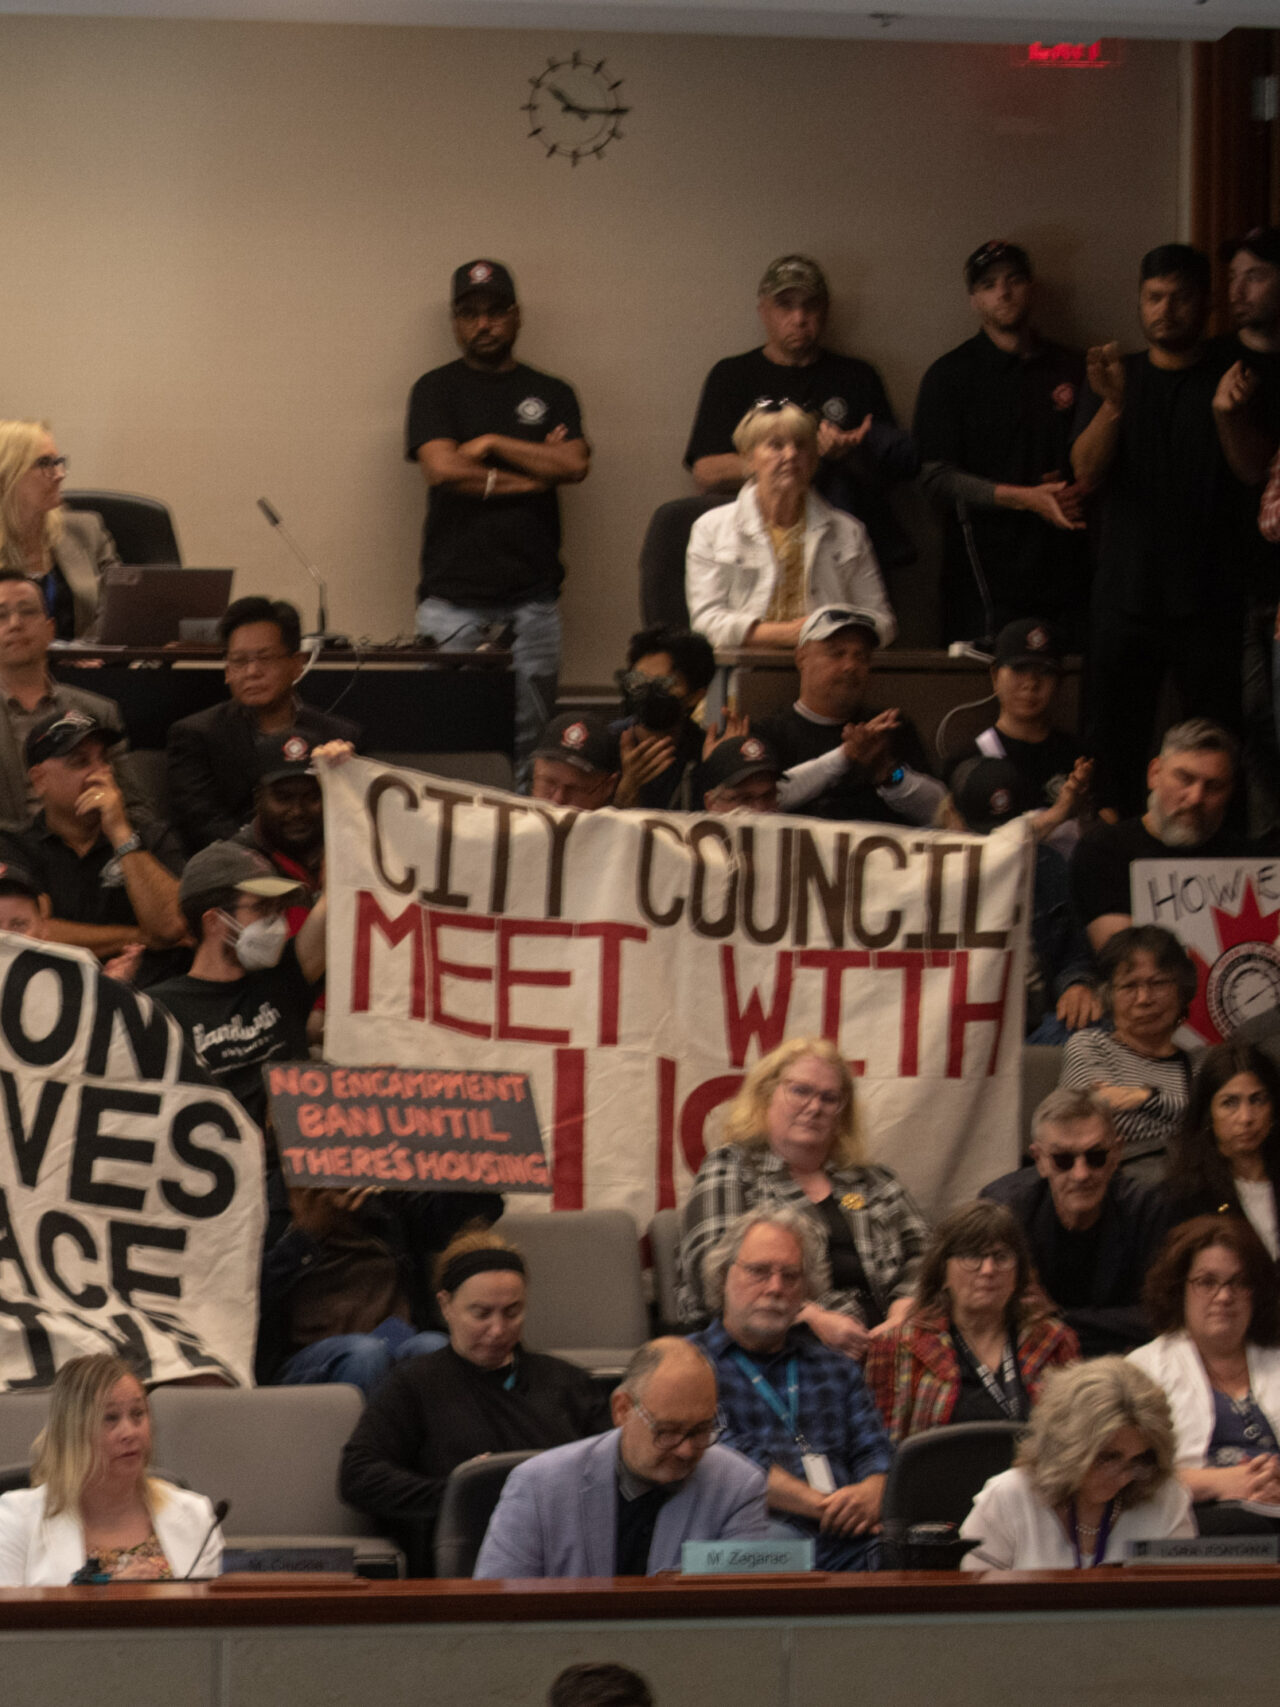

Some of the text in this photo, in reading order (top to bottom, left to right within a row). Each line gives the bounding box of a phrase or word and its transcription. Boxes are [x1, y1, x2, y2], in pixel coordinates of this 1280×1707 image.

[364, 773, 1020, 950] CITY COUNCIL
[351, 890, 1012, 1078] MEET WITH
[269, 1067, 527, 1101] NO ENCAMPMENT
[297, 1104, 511, 1142] BAN UNTIL
[283, 1140, 550, 1186] THERE'S HOUSING
